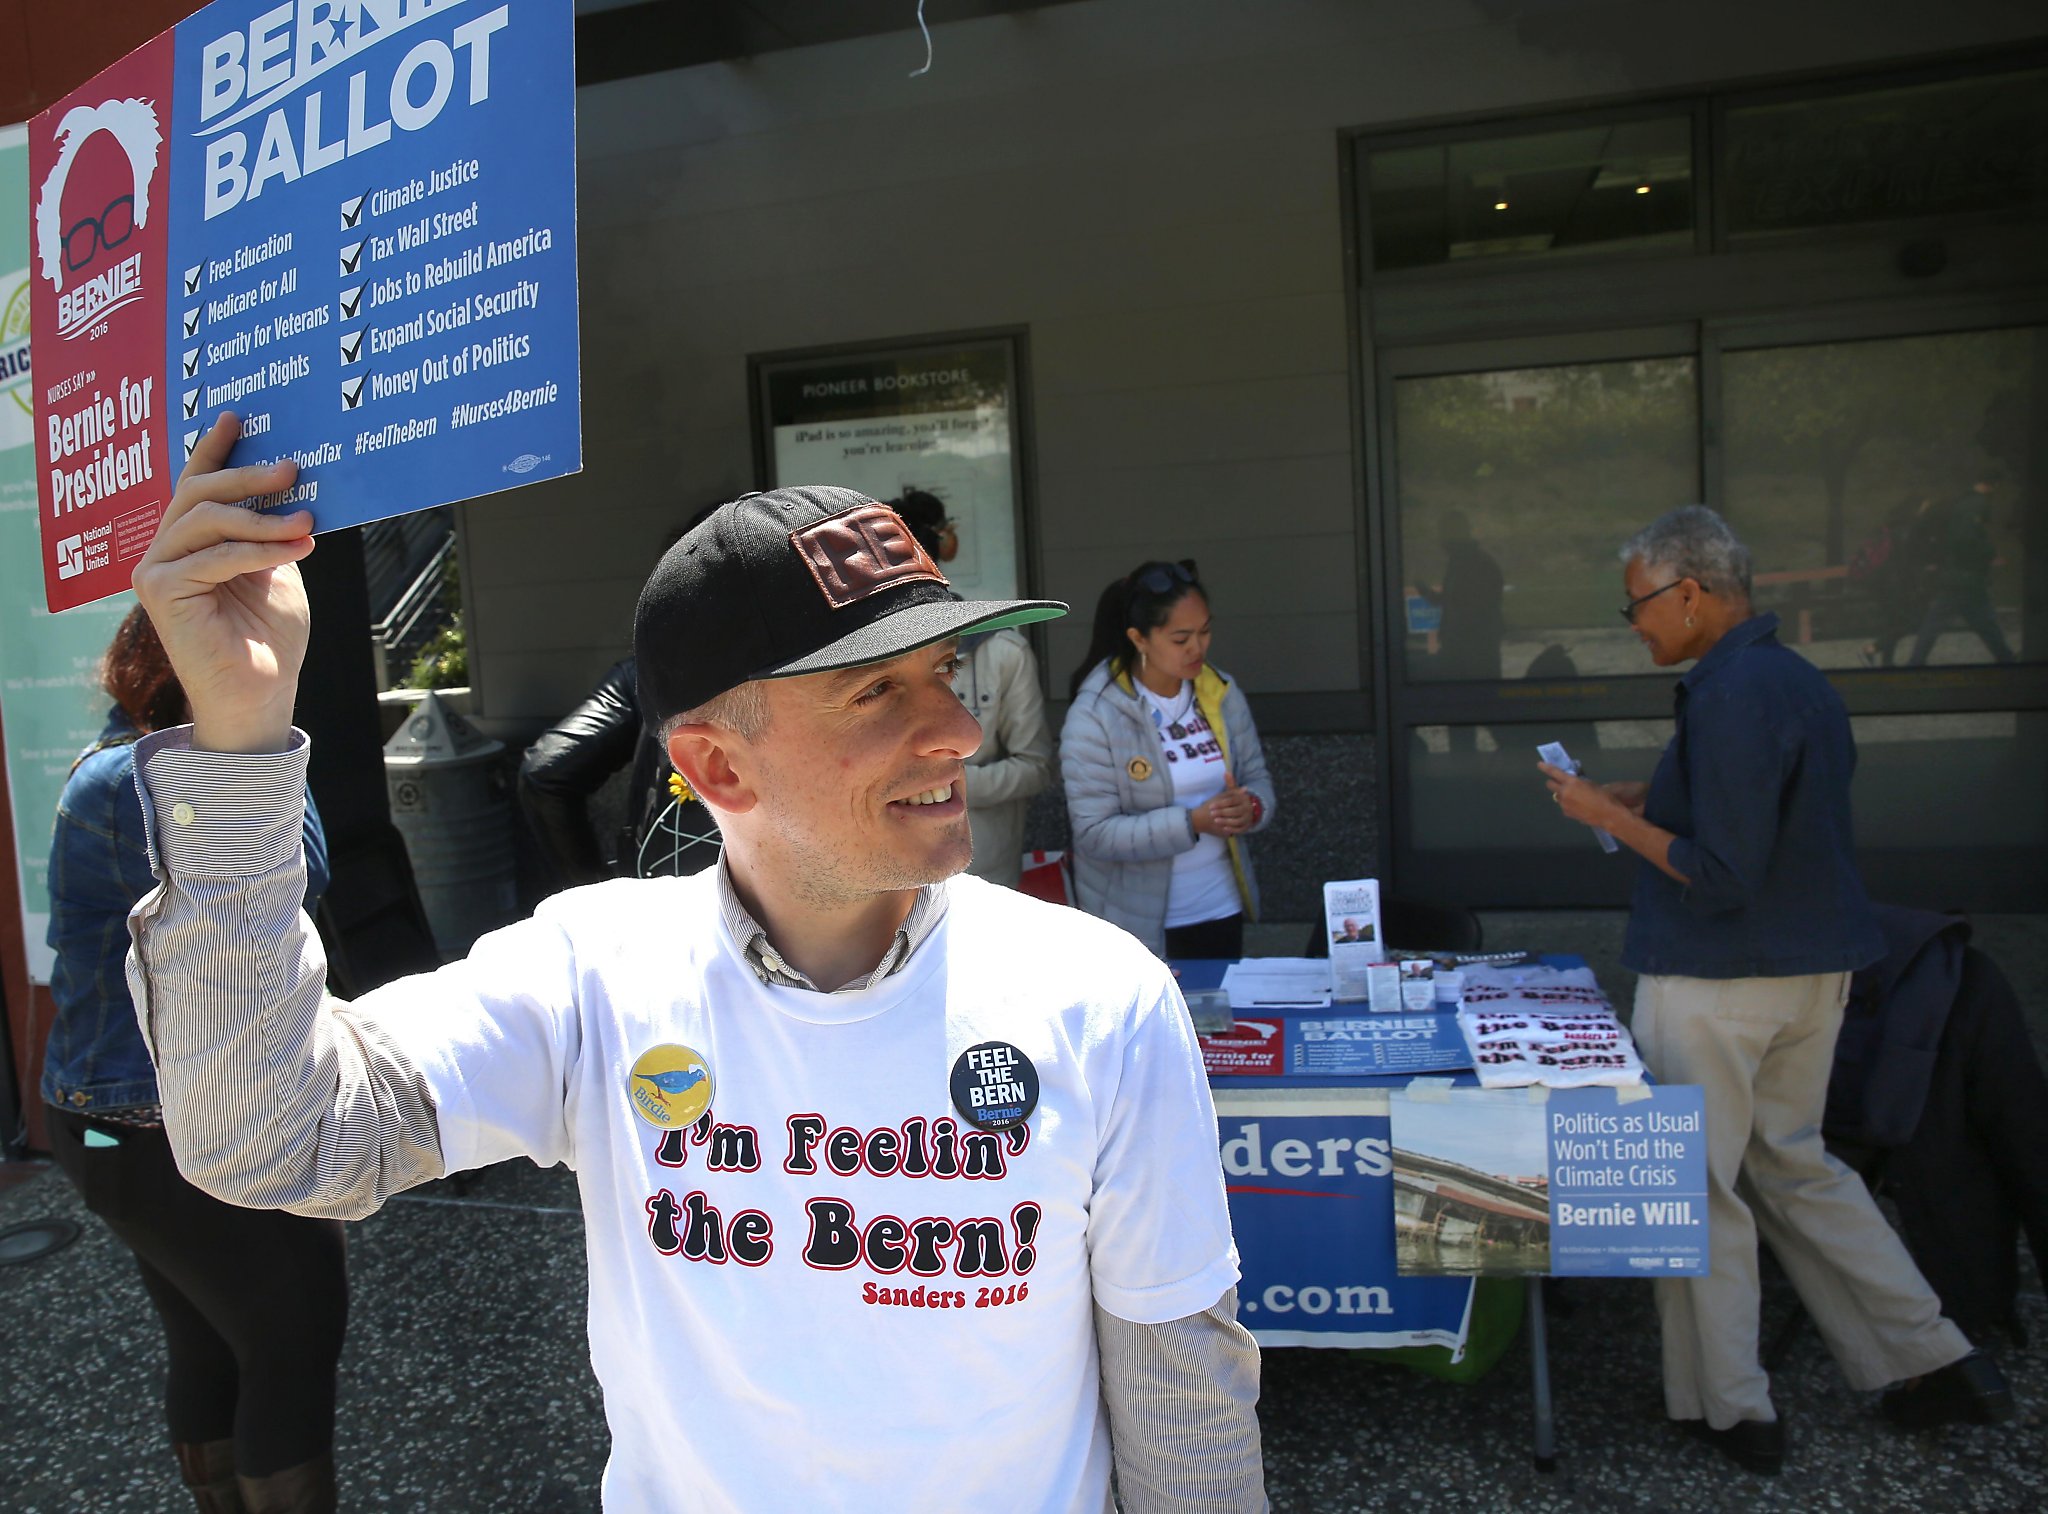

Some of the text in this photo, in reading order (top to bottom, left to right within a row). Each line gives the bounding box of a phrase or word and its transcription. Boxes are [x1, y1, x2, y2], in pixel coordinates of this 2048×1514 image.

[201, 0, 462, 122] BERN
[204, 4, 509, 221] BALLOT
[371, 159, 479, 217] Climate Justice
[371, 201, 478, 262] Tax Wall Street
[209, 232, 292, 284] Free Education
[370, 228, 551, 308] Jobs to Rebuild America
[58, 252, 142, 330] BERNIE!
[208, 267, 297, 325] Medicare for All
[90, 322, 108, 341] 2016
[370, 280, 539, 354] Expand Social Security
[207, 304, 330, 366] Security for Veterans
[0, 345, 31, 380] RIC
[372, 333, 530, 400] Money Out of Politics
[47, 371, 85, 405] NURSES SAY
[207, 354, 310, 408] Immigrant Rights
[802, 368, 969, 398] PIONEER BOOKSTORE
[48, 376, 153, 463] Bernie for
[238, 413, 271, 440] acism
[355, 380, 557, 455] #FeelTheBern #Nurses4Bernie
[51, 429, 153, 518] President
[83, 521, 113, 543] National
[84, 540, 109, 557] Nurses
[85, 553, 110, 571] United
[1300, 1018, 1436, 1032] BERNIE!
[1304, 1029, 1438, 1041] BALLOT
[966, 1046, 1019, 1070] FEEL
[1202, 1052, 1275, 1060] ernie for
[1204, 1059, 1272, 1067] resident
[976, 1066, 1013, 1086] THE
[634, 1086, 671, 1124] Birdie
[969, 1081, 1026, 1108] BERN
[977, 1105, 1022, 1121] Bernie
[992, 1119, 1010, 1127] 2016
[1553, 1110, 1700, 1134] Politics as Usual
[655, 1109, 1030, 1181] I'm Feelin'
[1554, 1138, 1685, 1161] Won't End the
[1555, 1164, 1677, 1188] Climate Crisis
[1557, 1201, 1700, 1227] Bernie Will.
[645, 1188, 1042, 1279] the Bern!
[861, 1280, 1029, 1310] Sanders 2016
[1238, 1284, 1394, 1316] .com
